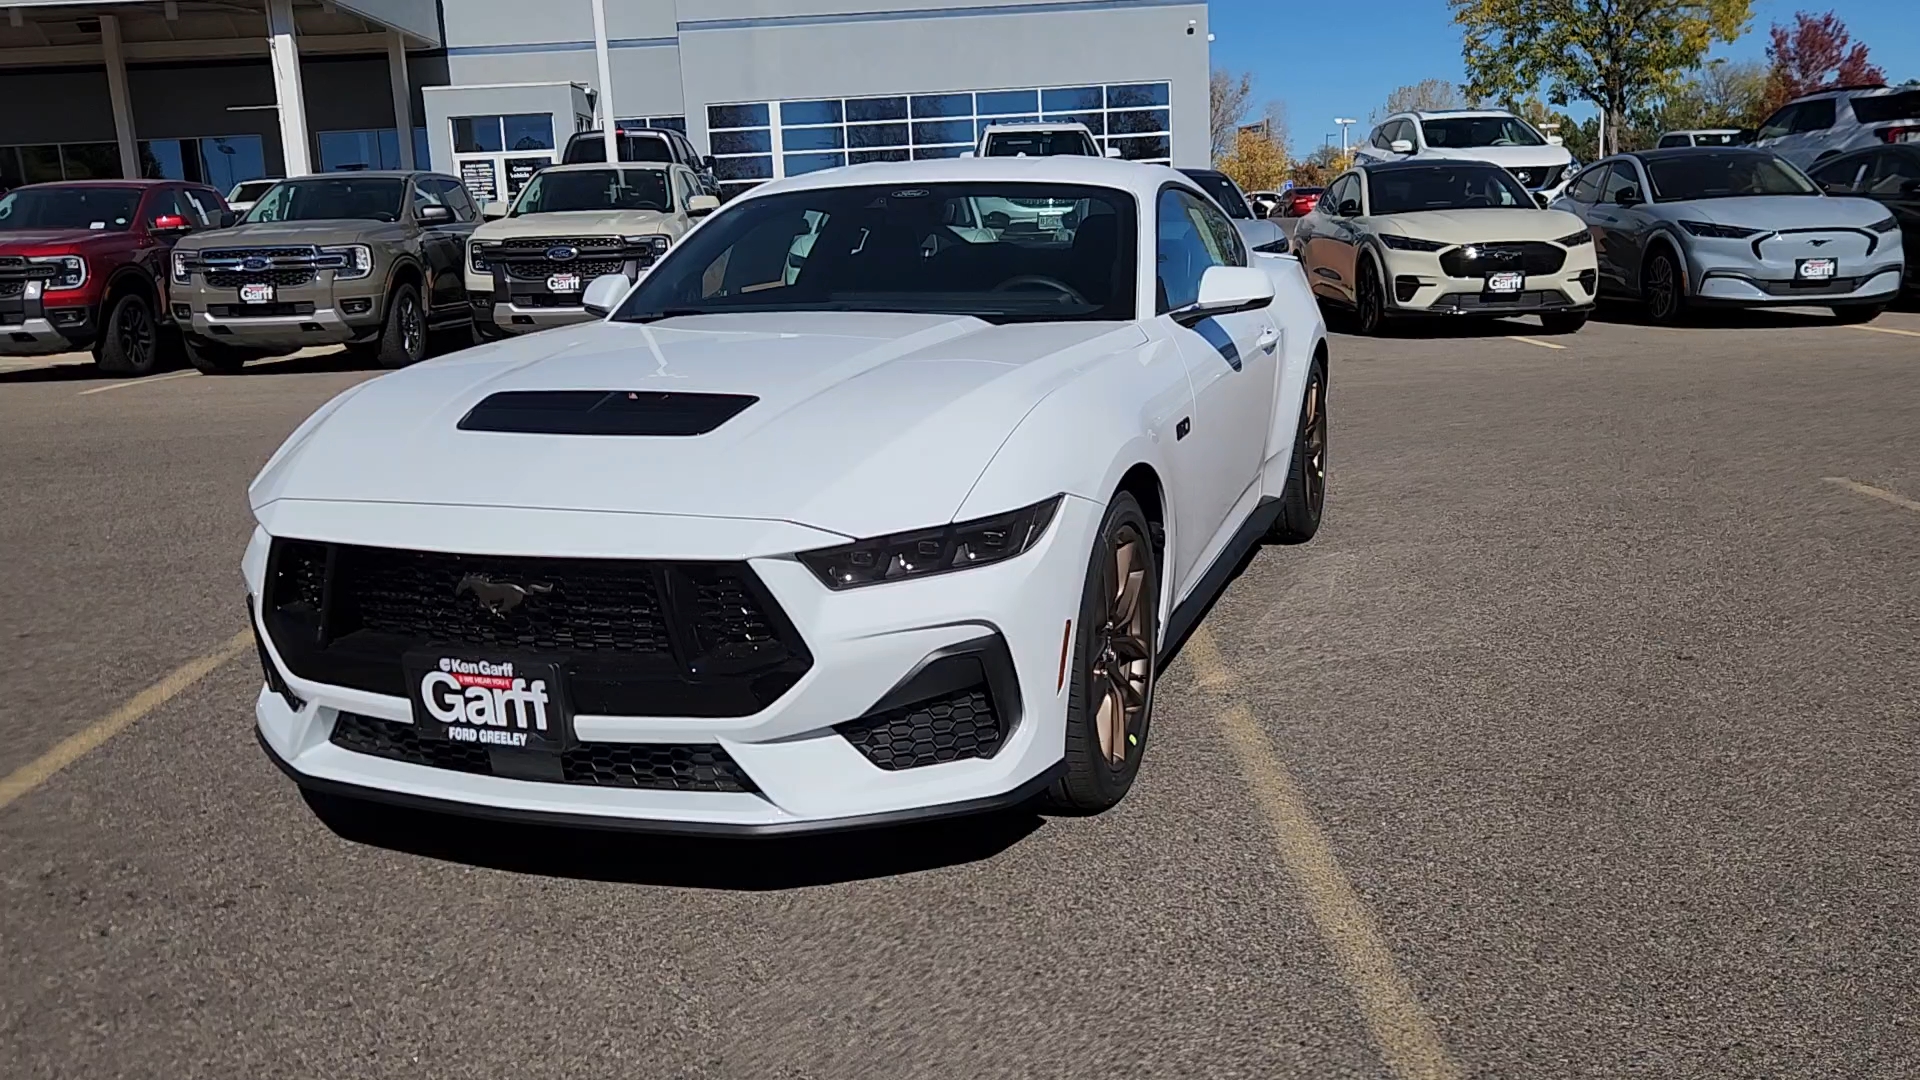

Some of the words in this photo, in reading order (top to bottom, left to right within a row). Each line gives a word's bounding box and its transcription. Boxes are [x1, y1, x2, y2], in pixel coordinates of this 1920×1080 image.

[1800, 262, 1835, 276] Garff
[547, 276, 580, 290] Garff
[1488, 275, 1522, 290] Garff
[240, 286, 273, 301] Garff
[451, 659, 479, 674] Ken
[478, 660, 514, 677] Garff
[421, 671, 549, 731] Garff
[449, 726, 478, 742] FORD
[479, 729, 527, 747] GREELEY
